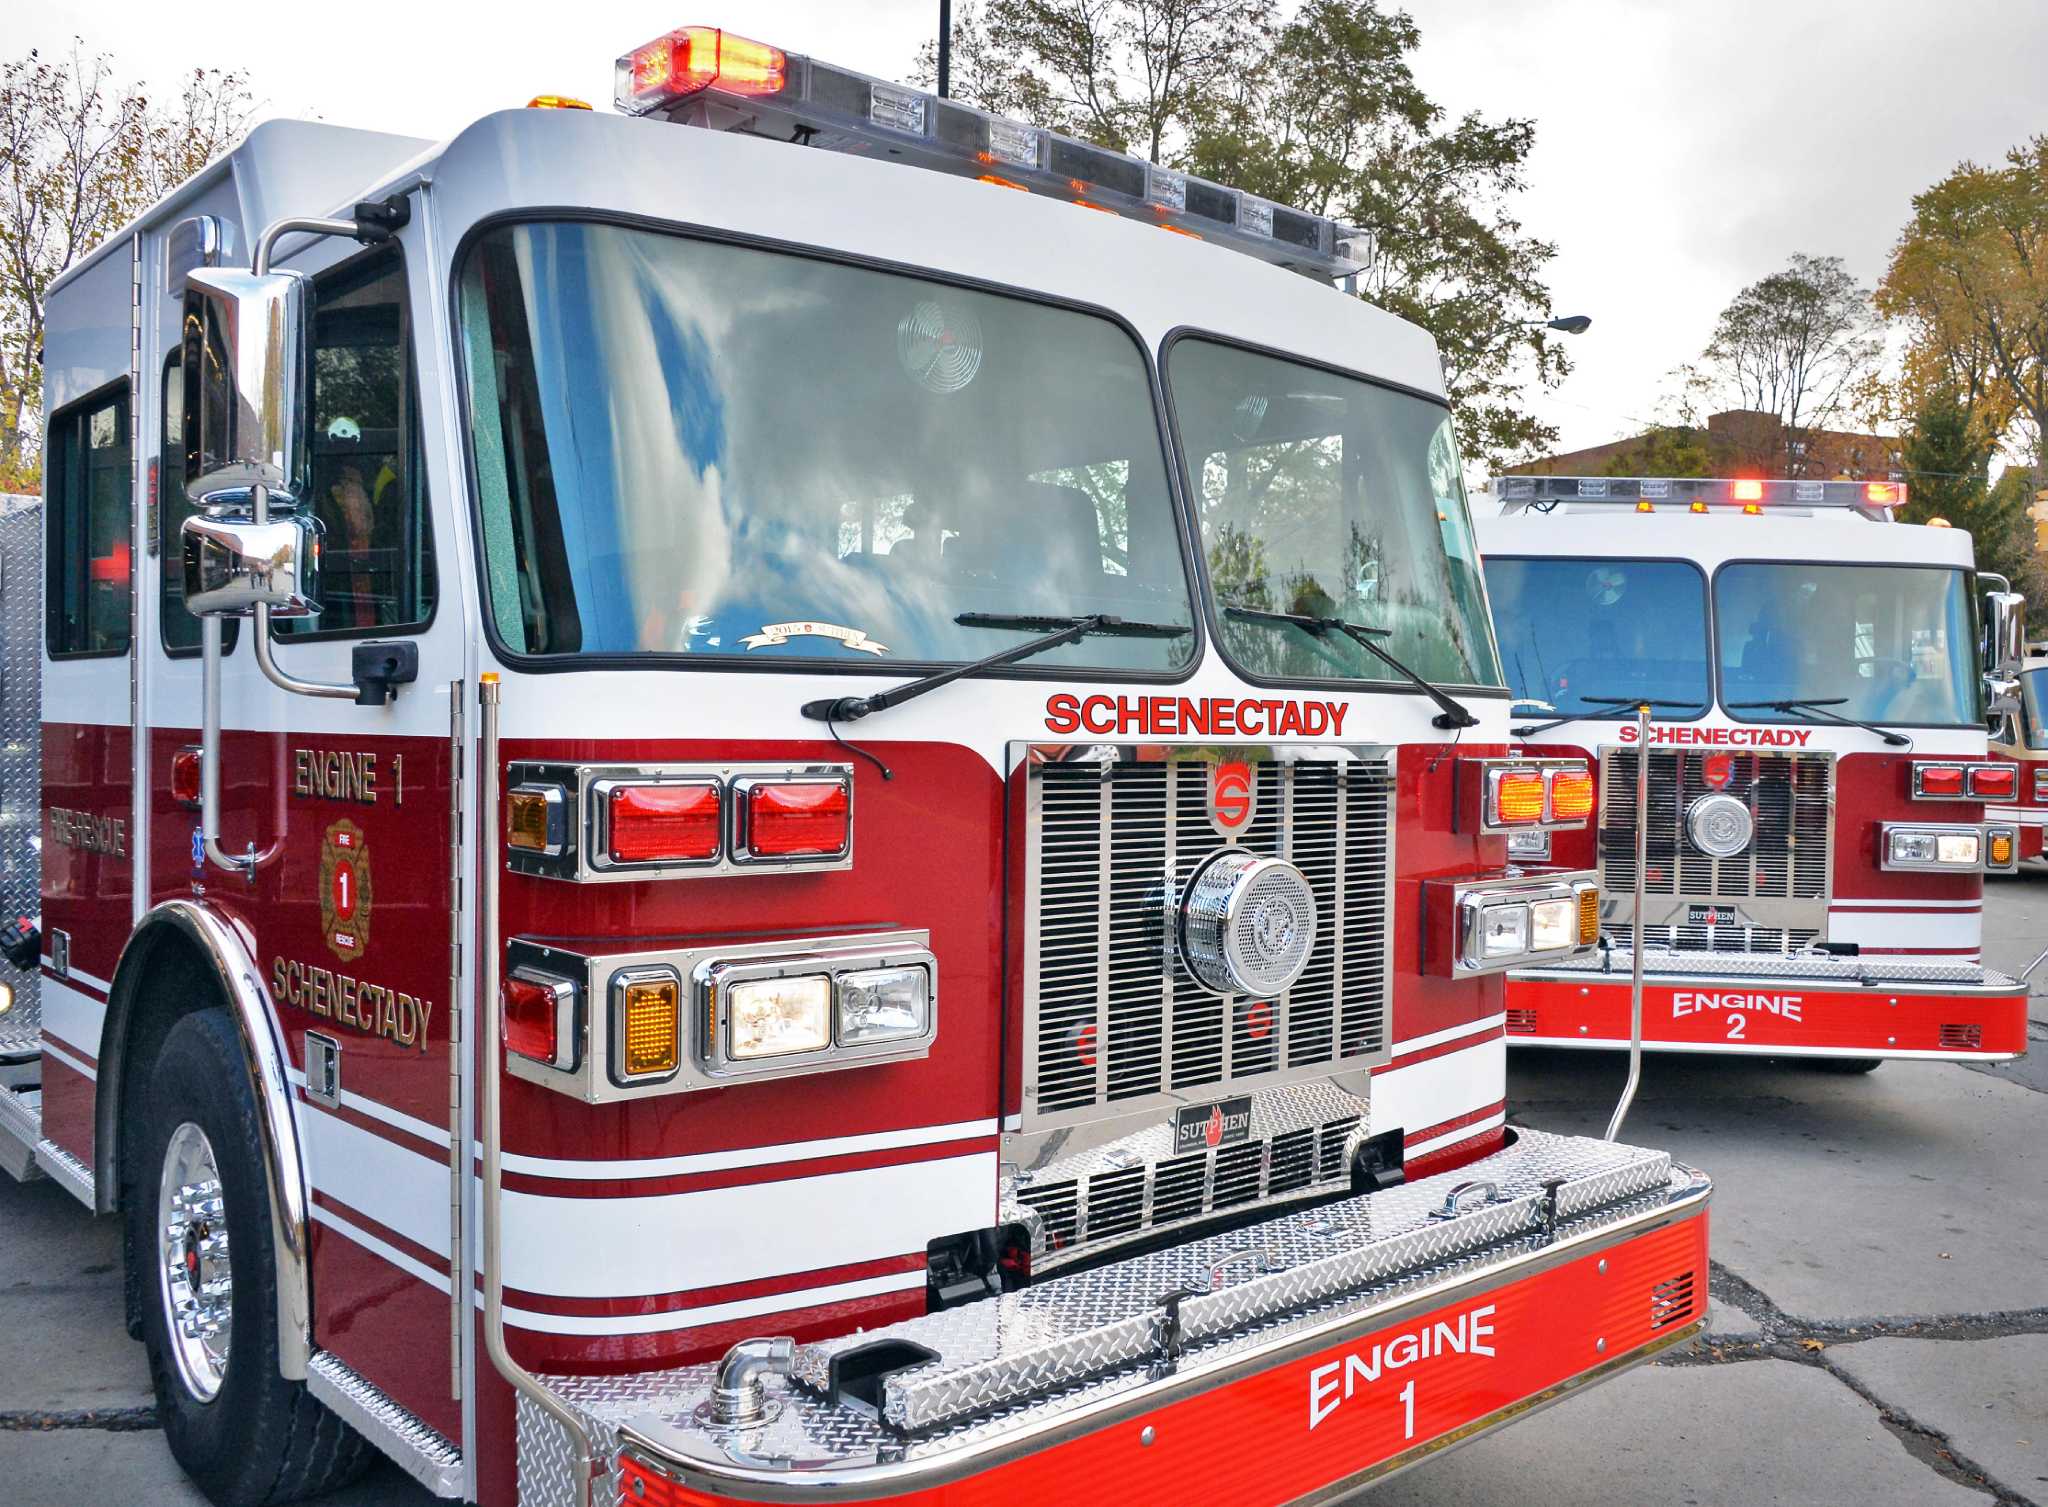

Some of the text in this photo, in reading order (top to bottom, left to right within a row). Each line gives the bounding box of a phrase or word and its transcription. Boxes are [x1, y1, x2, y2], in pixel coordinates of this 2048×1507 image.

[1045, 694, 1349, 736] SCHENECTADY
[295, 750, 404, 806] ENGINE 1
[339, 872, 348, 908] 1
[1688, 911, 1736, 921] SUTPHEN
[272, 956, 432, 1053] SCHENECTADY
[1672, 992, 1803, 1022] ENGINE
[1726, 1014, 1745, 1040] 2
[1180, 1112, 1249, 1140] SUTPHEN
[1309, 1304, 1496, 1431] ENGINE
[1399, 1380, 1415, 1440] 1
